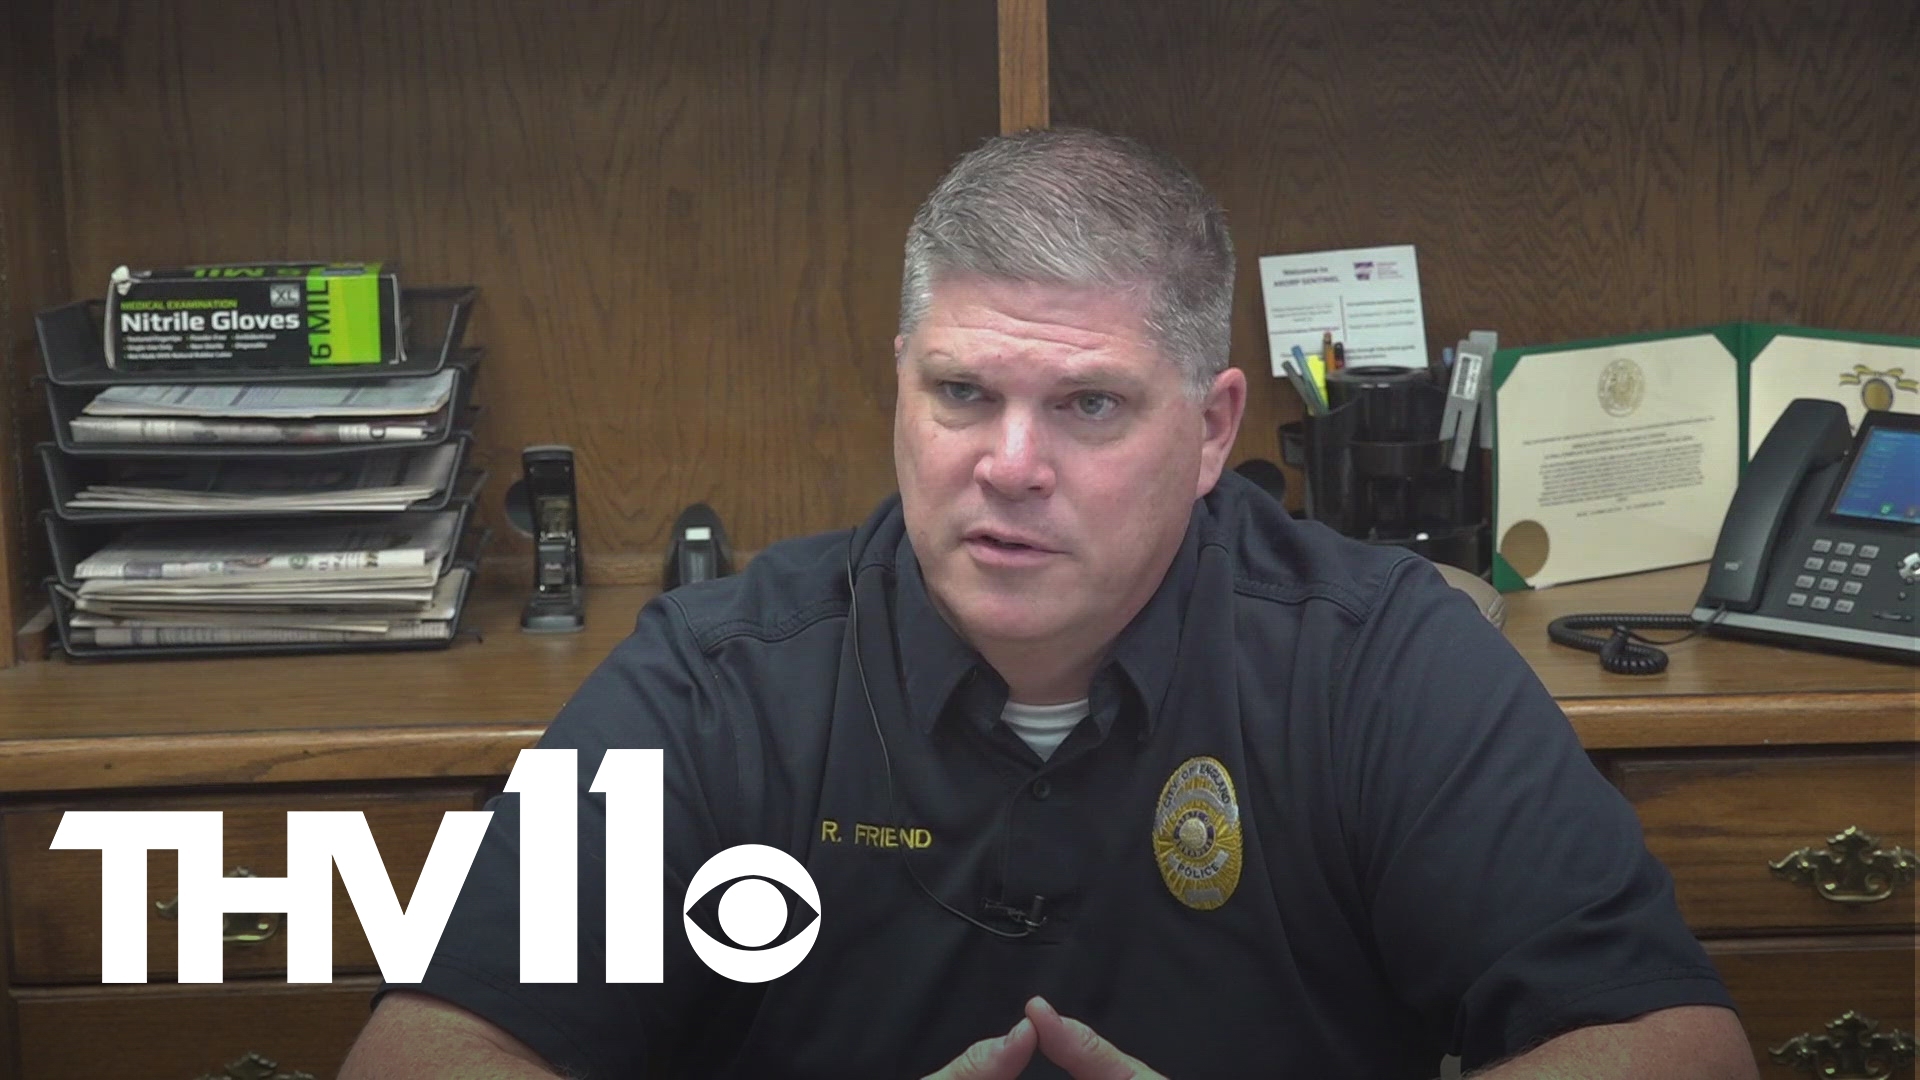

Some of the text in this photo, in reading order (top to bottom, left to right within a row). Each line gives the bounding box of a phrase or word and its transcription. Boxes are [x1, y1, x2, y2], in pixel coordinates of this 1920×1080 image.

[120, 299, 238, 311] MEDICAL EXAMINATION
[276, 289, 295, 301] XL
[120, 310, 301, 332] Nitrile Gloves
[307, 280, 332, 360] 6 MIL
[1181, 767, 1195, 780] OF
[1199, 763, 1231, 804] ENGLAND
[821, 820, 933, 849] R. FRIEND
[1176, 862, 1220, 879] POLICE
